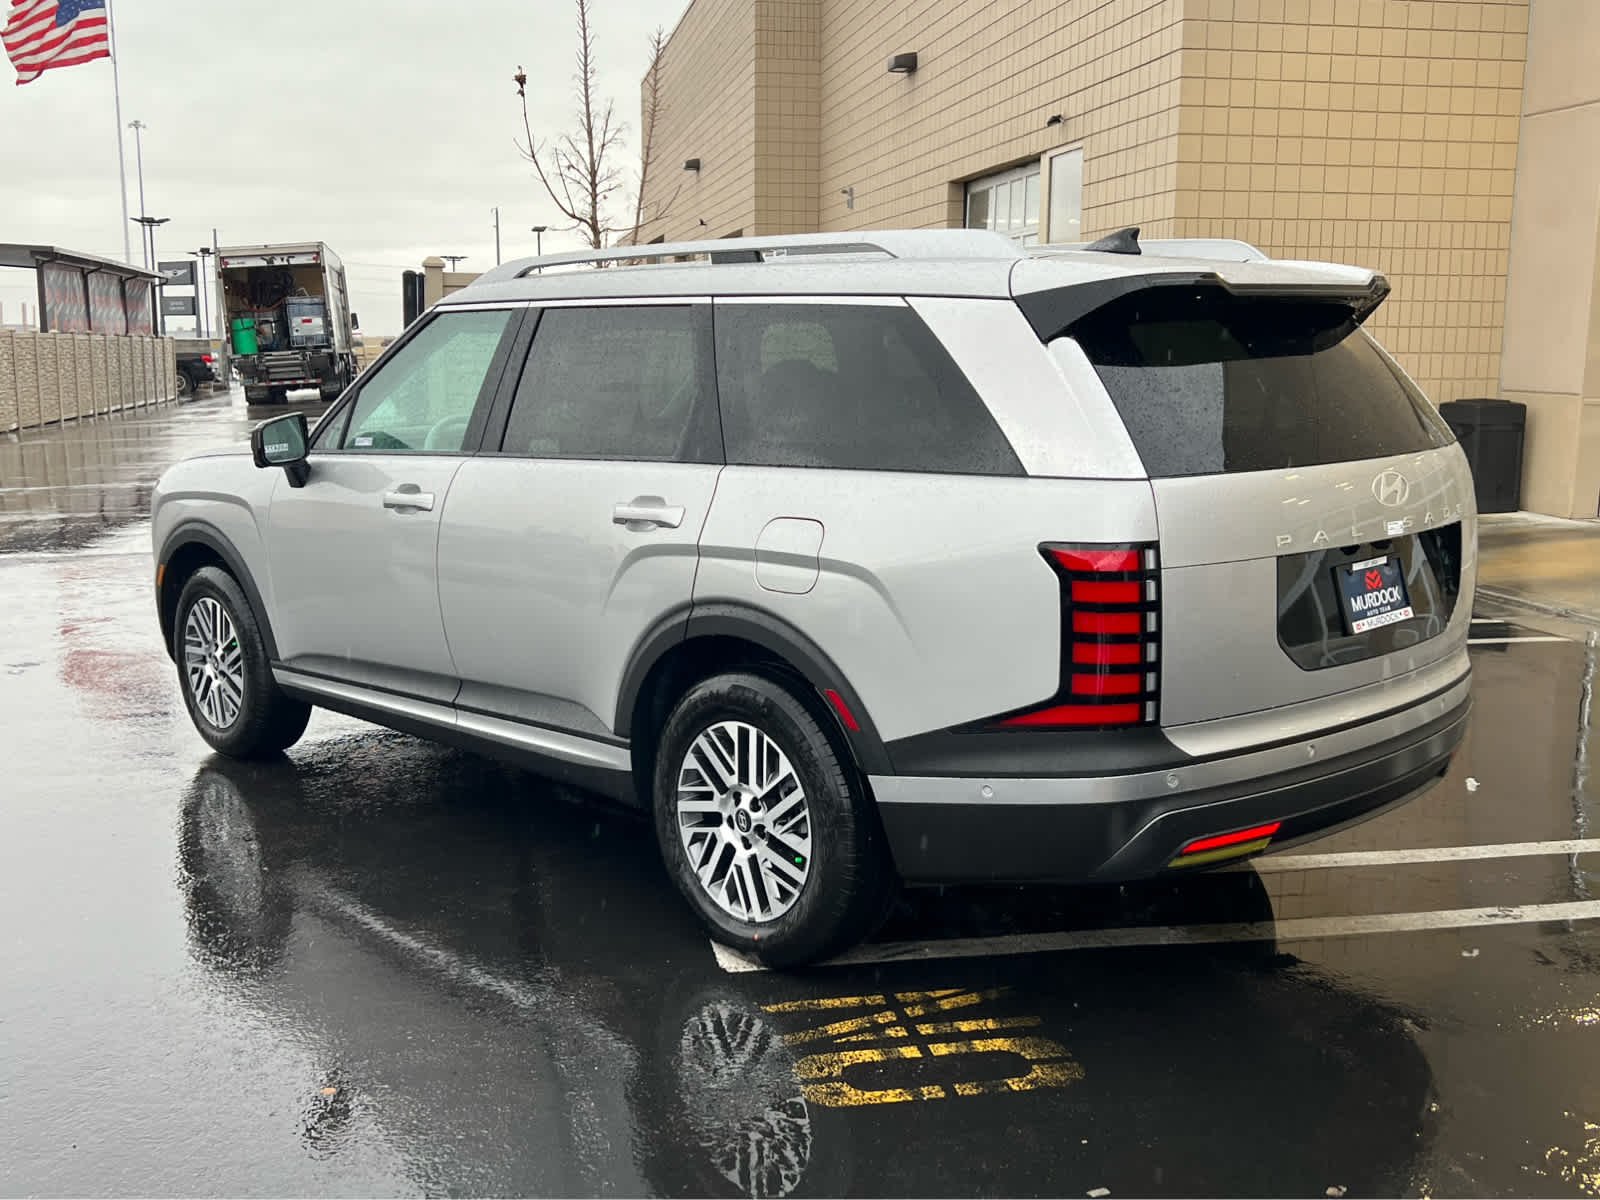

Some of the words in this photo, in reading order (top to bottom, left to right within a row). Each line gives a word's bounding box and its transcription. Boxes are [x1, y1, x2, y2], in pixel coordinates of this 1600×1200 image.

[1276, 503, 1464, 548] PALISADE
[1351, 586, 1401, 612] MURDOCK
[1366, 608, 1379, 616] AUTO
[1380, 605, 1392, 614] TEAM
[1366, 612, 1399, 625] MURDOCK
